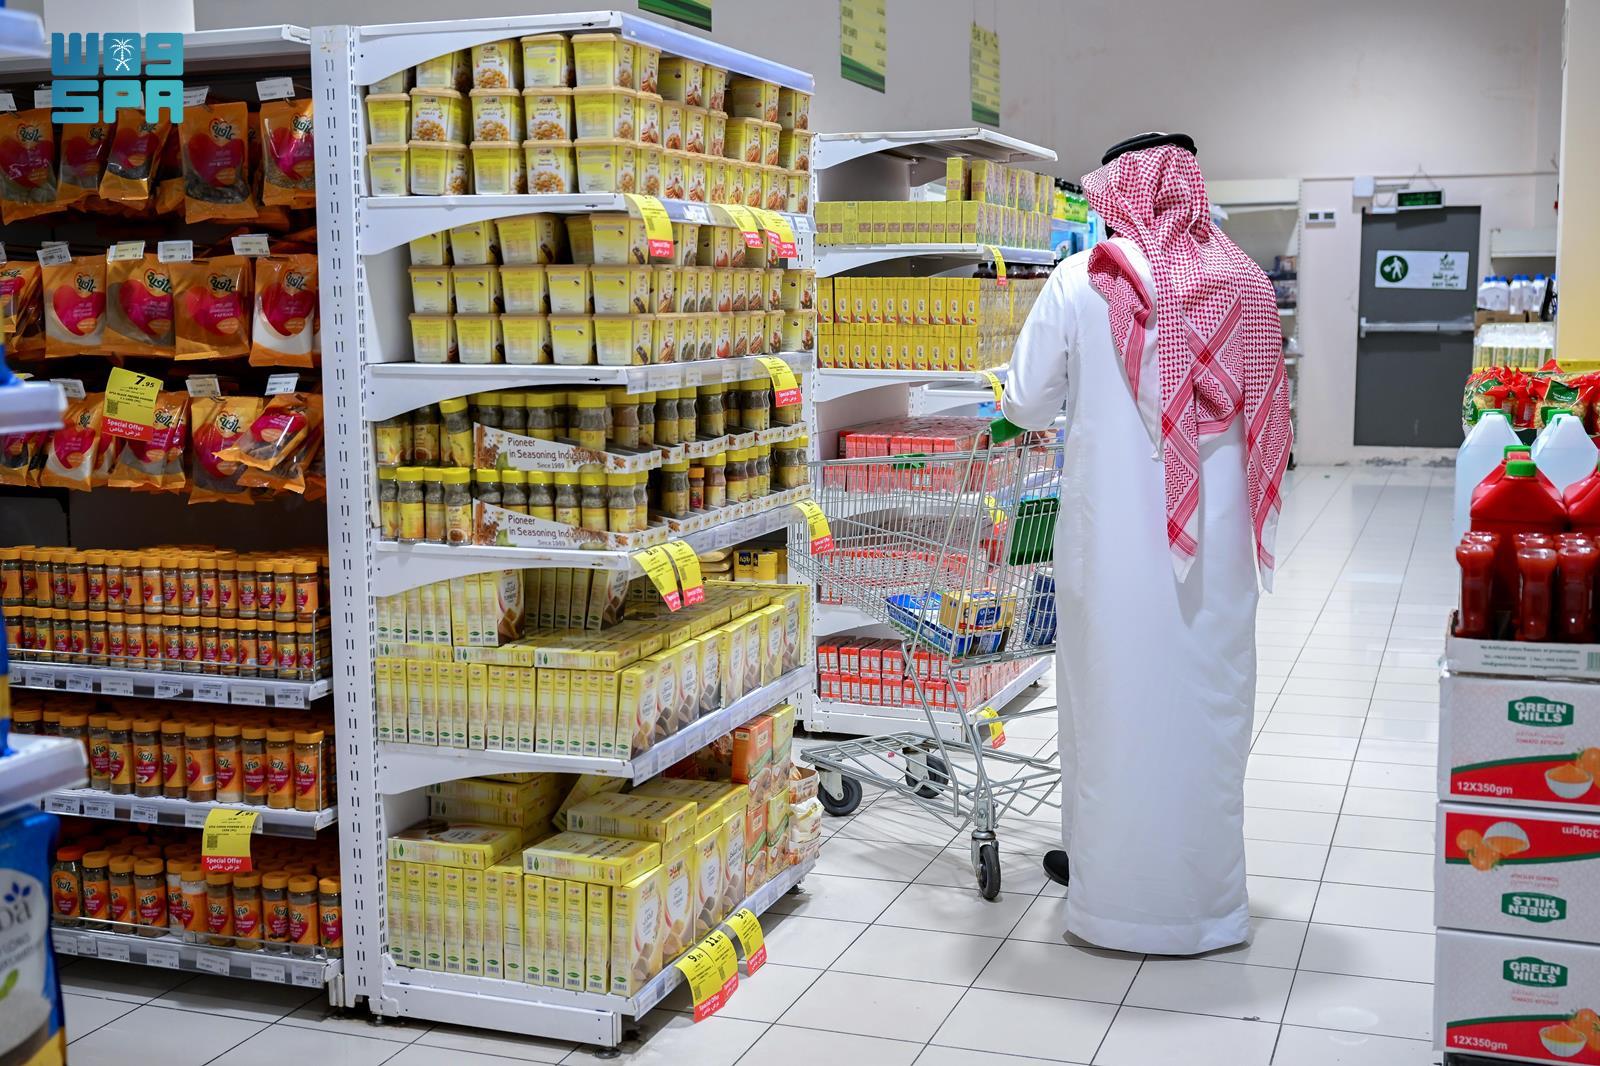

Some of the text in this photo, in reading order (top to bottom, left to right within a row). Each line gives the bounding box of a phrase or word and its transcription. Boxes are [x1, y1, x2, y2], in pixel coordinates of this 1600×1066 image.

[134, 375, 155, 388] 7.95
[108, 419, 144, 431] Special Offer
[508, 437, 535, 447] Pioneer
[510, 450, 516, 458] in
[518, 450, 556, 462] Seasoning
[508, 515, 535, 524] Pioneer
[510, 527, 516, 536] in
[518, 528, 557, 538] Seasoning
[1514, 702, 1567, 714] GREEN
[1518, 712, 1562, 722] HILLS
[1457, 782, 1513, 795] 12X350gm
[1512, 896, 1556, 908] HILLS
[1508, 904, 1560, 918] GREEN
[1509, 962, 1561, 975] GREEN
[1514, 973, 1557, 984] HILLS
[1453, 1034, 1508, 1050] 12X350gm
